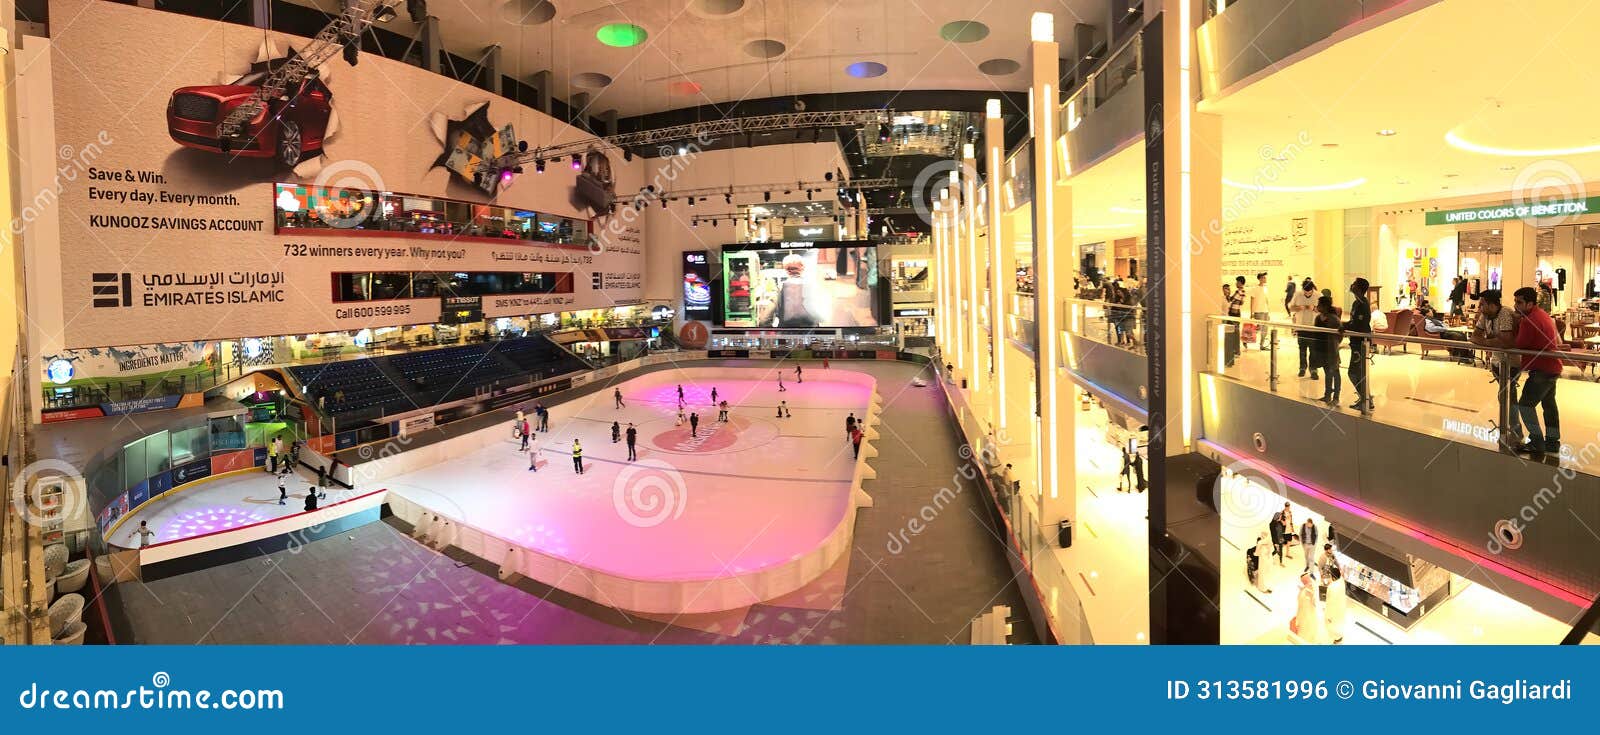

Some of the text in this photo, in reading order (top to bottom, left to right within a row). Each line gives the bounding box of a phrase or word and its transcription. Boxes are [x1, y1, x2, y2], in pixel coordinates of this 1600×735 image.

[88, 167, 167, 184] Save & Win.
[88, 187, 240, 206] Every day. Every month.
[89, 215, 264, 231] KUNOOZ SAVINGS ACCOUNT
[1445, 211, 1477, 222] UNITED
[1477, 208, 1514, 220] COLORS
[1515, 207, 1529, 217] OF
[283, 244, 466, 261] 732 winners every year. Why not you?
[143, 271, 285, 291] الإمارات الإسلامي
[143, 289, 284, 306] EMIRATES ISLAMIC
[335, 304, 411, 319] Call 600 599 995
[119, 351, 185, 372] INGREDIENTS MATTER
